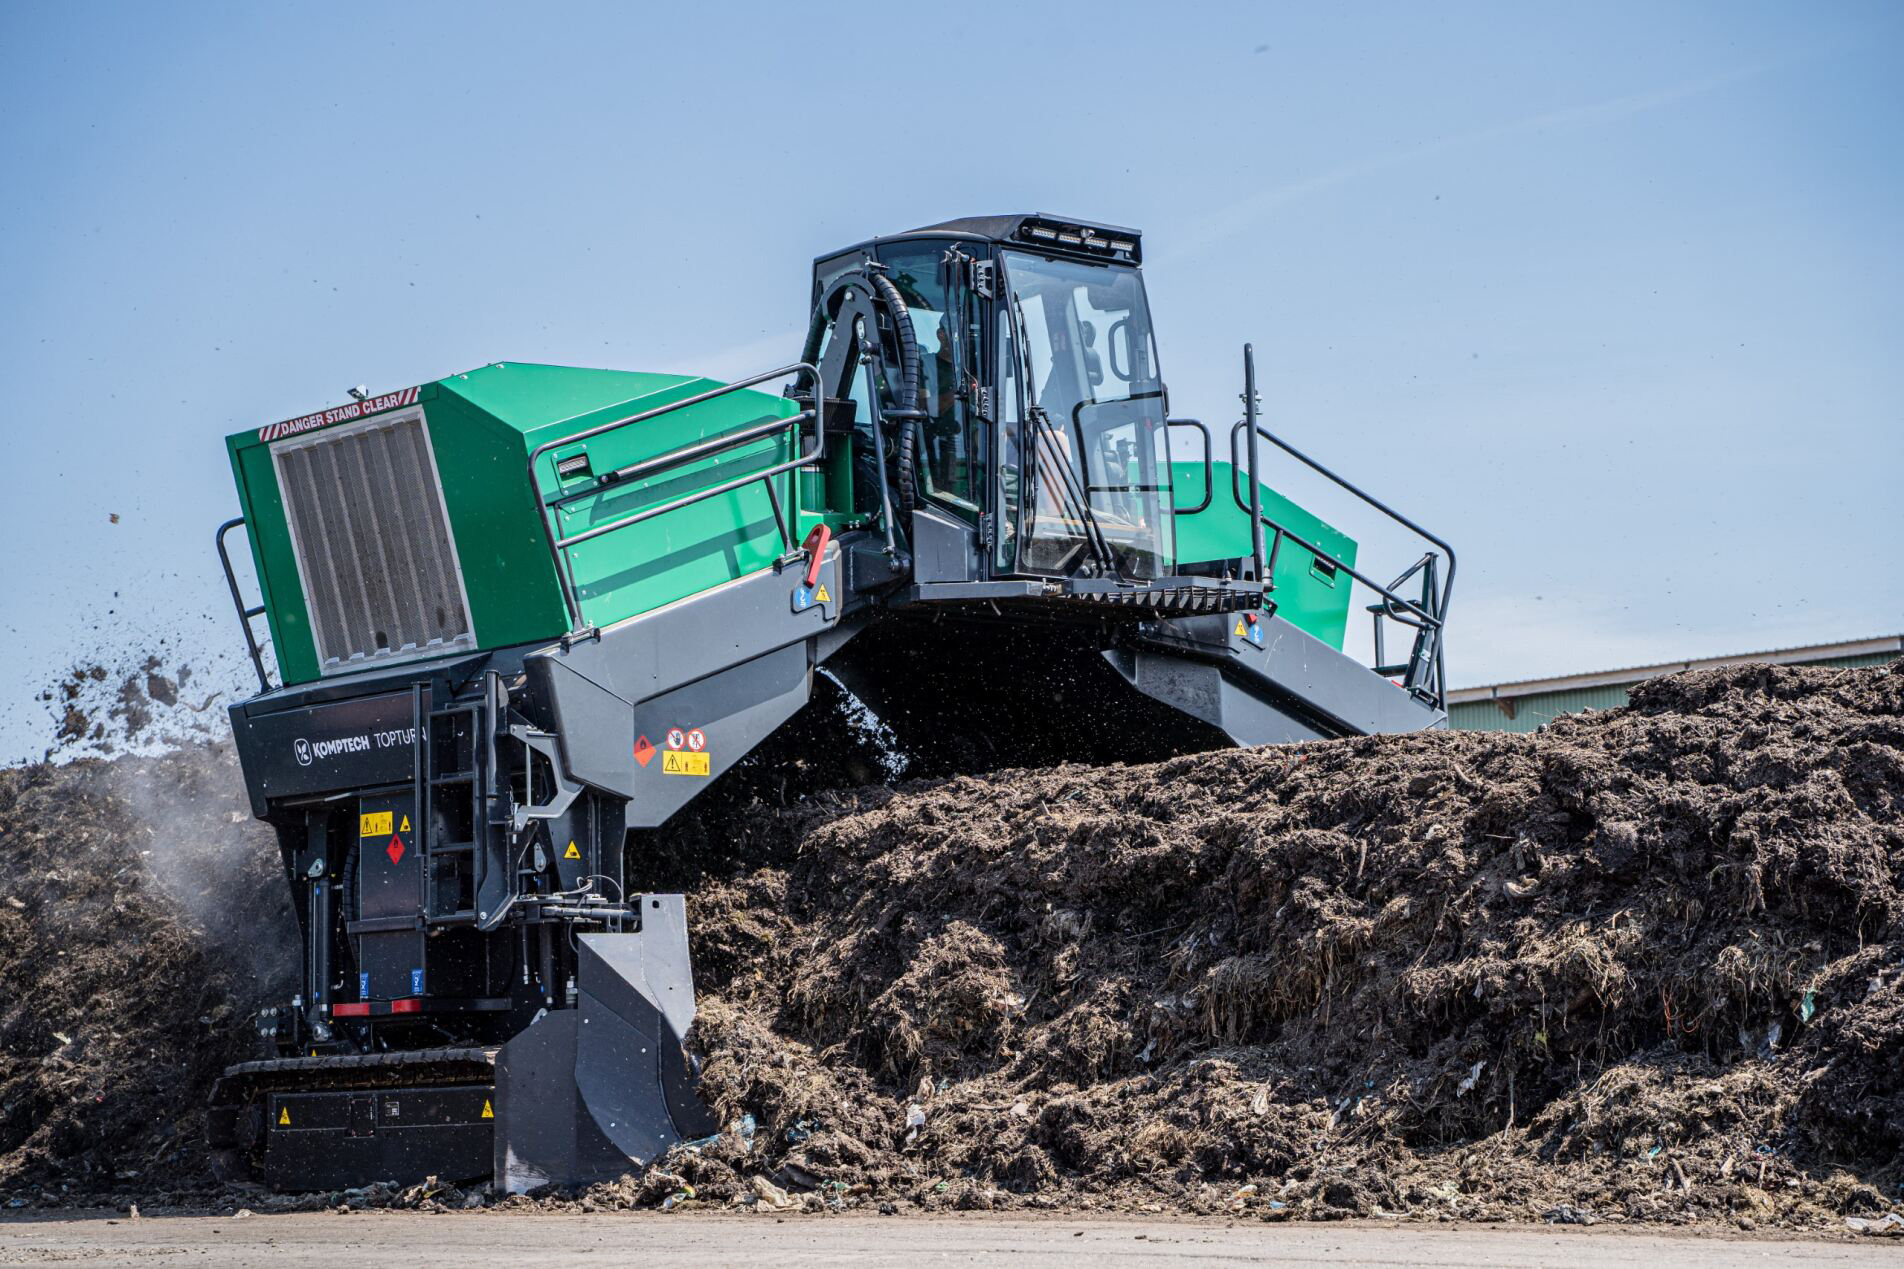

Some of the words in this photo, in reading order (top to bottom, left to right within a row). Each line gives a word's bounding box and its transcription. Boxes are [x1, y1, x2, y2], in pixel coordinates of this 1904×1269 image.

[281, 414, 325, 436] DANGER
[326, 404, 361, 424] STAND
[362, 395, 399, 414] CLEAR
[312, 735, 370, 759] KOMPTECH
